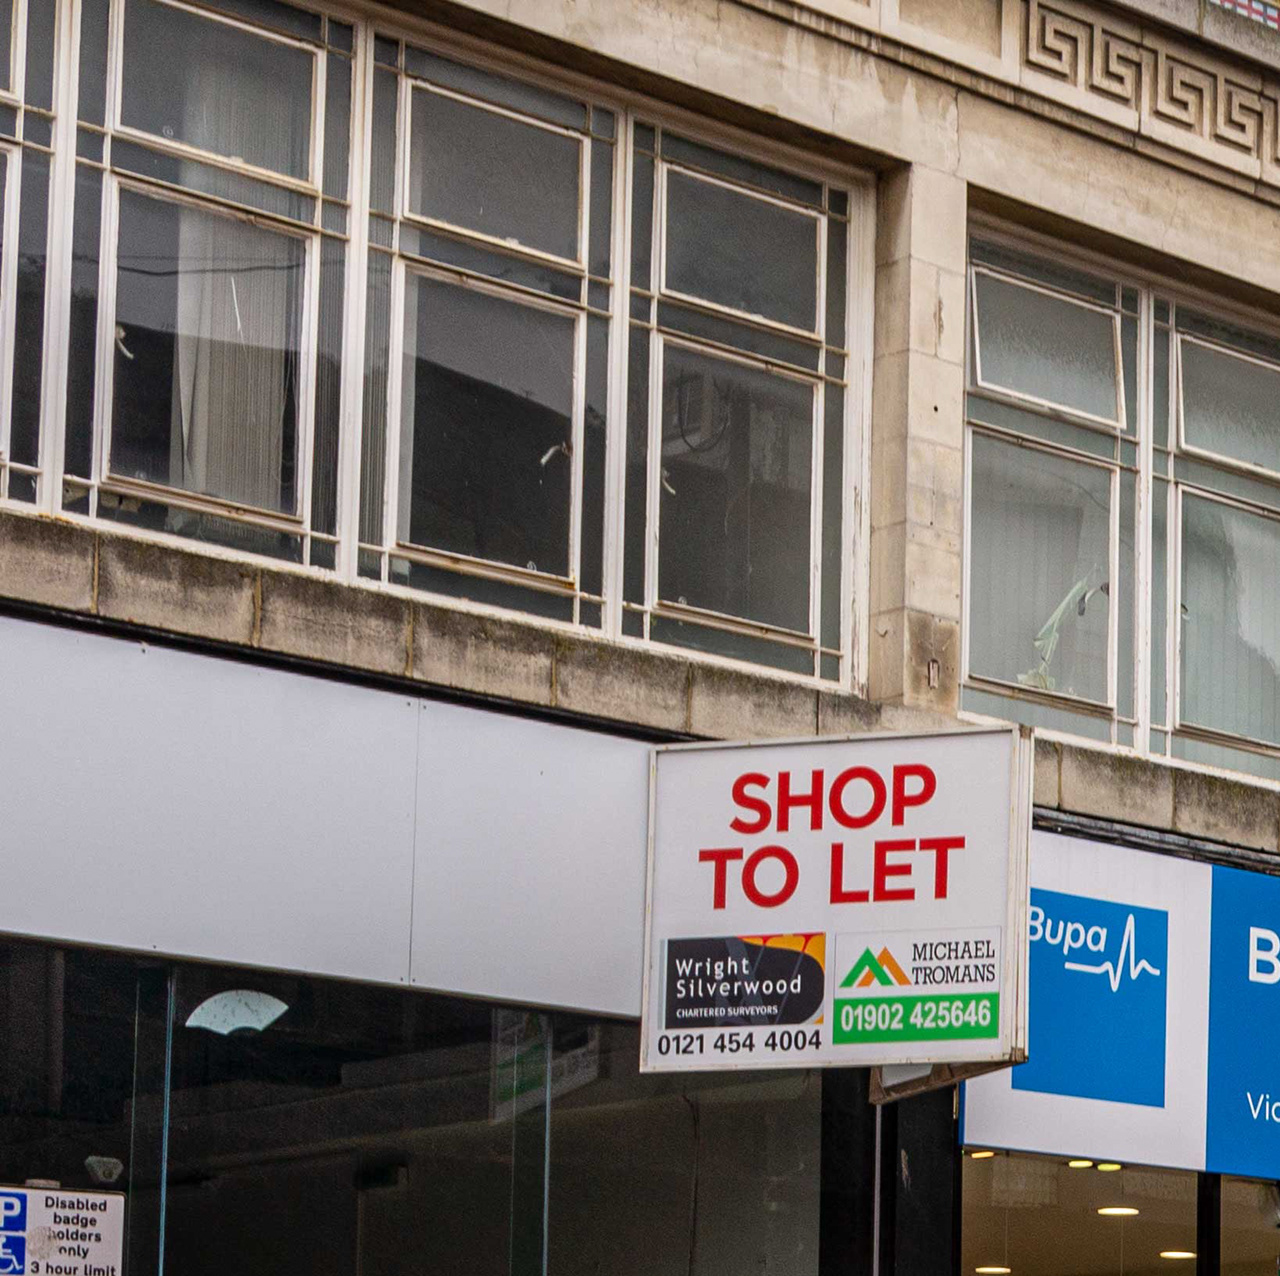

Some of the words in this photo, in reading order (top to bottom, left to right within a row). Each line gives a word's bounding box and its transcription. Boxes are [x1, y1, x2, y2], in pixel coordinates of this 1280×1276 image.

[729, 764, 937, 835] SHOP
[699, 844, 800, 911] TO
[829, 836, 966, 904] LET
[1028, 905, 1108, 956] Bupa
[912, 941, 996, 962] MICHAEL
[676, 957, 749, 980] Wright
[911, 964, 996, 986] TROMANS
[676, 974, 802, 999] Silverwood
[676, 1006, 726, 1018] CHARTERED
[727, 1005, 778, 1017] SURVEYORS
[840, 1004, 904, 1032] 01902
[910, 1000, 991, 1029] 425646
[657, 1033, 704, 1056] 0121
[713, 1032, 756, 1054] 454
[764, 1030, 822, 1052] 4004
[45, 1196, 108, 1212] Disabled
[53, 1212, 97, 1228] badge
[31, 1261, 39, 1275] 3
[46, 1262, 78, 1276] hour
